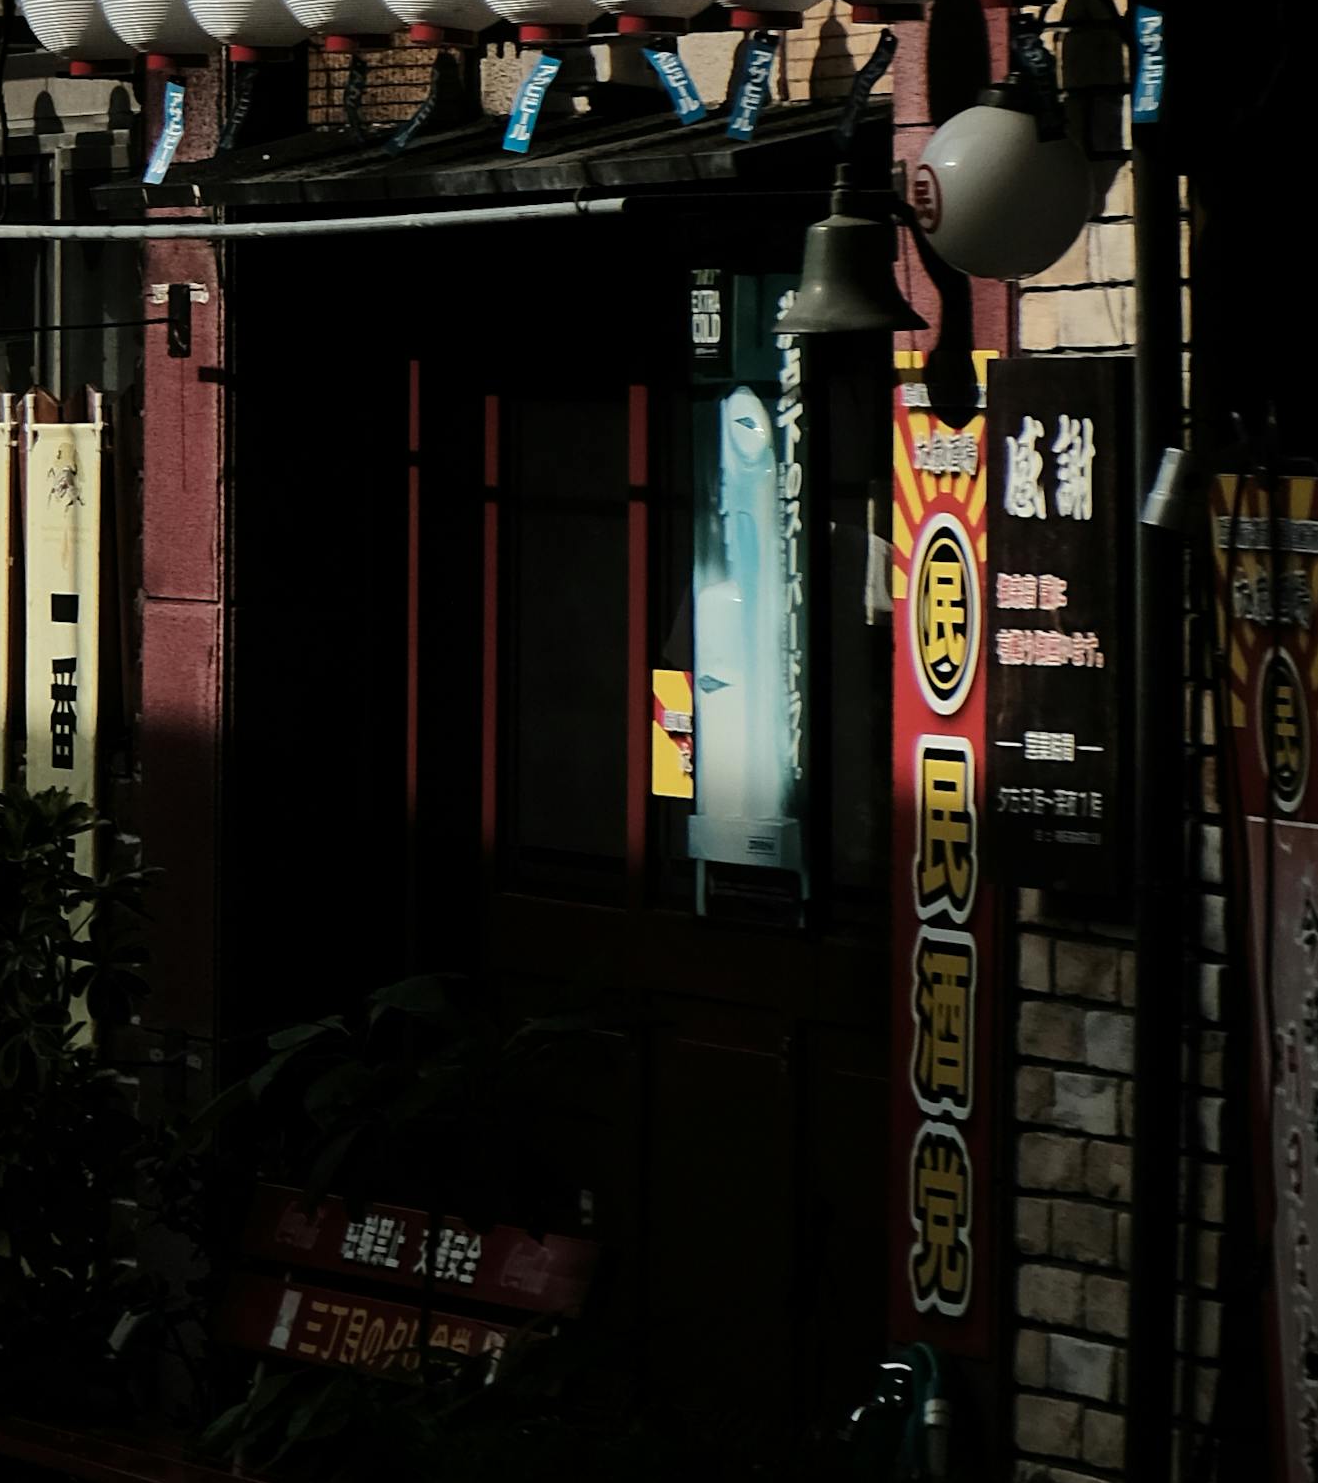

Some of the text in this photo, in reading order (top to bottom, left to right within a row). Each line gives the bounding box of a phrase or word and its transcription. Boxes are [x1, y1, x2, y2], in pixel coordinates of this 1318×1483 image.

[1003, 414, 1096, 521] 感謝
[927, 560, 967, 664] 民
[915, 754, 973, 1298] 民酒党
